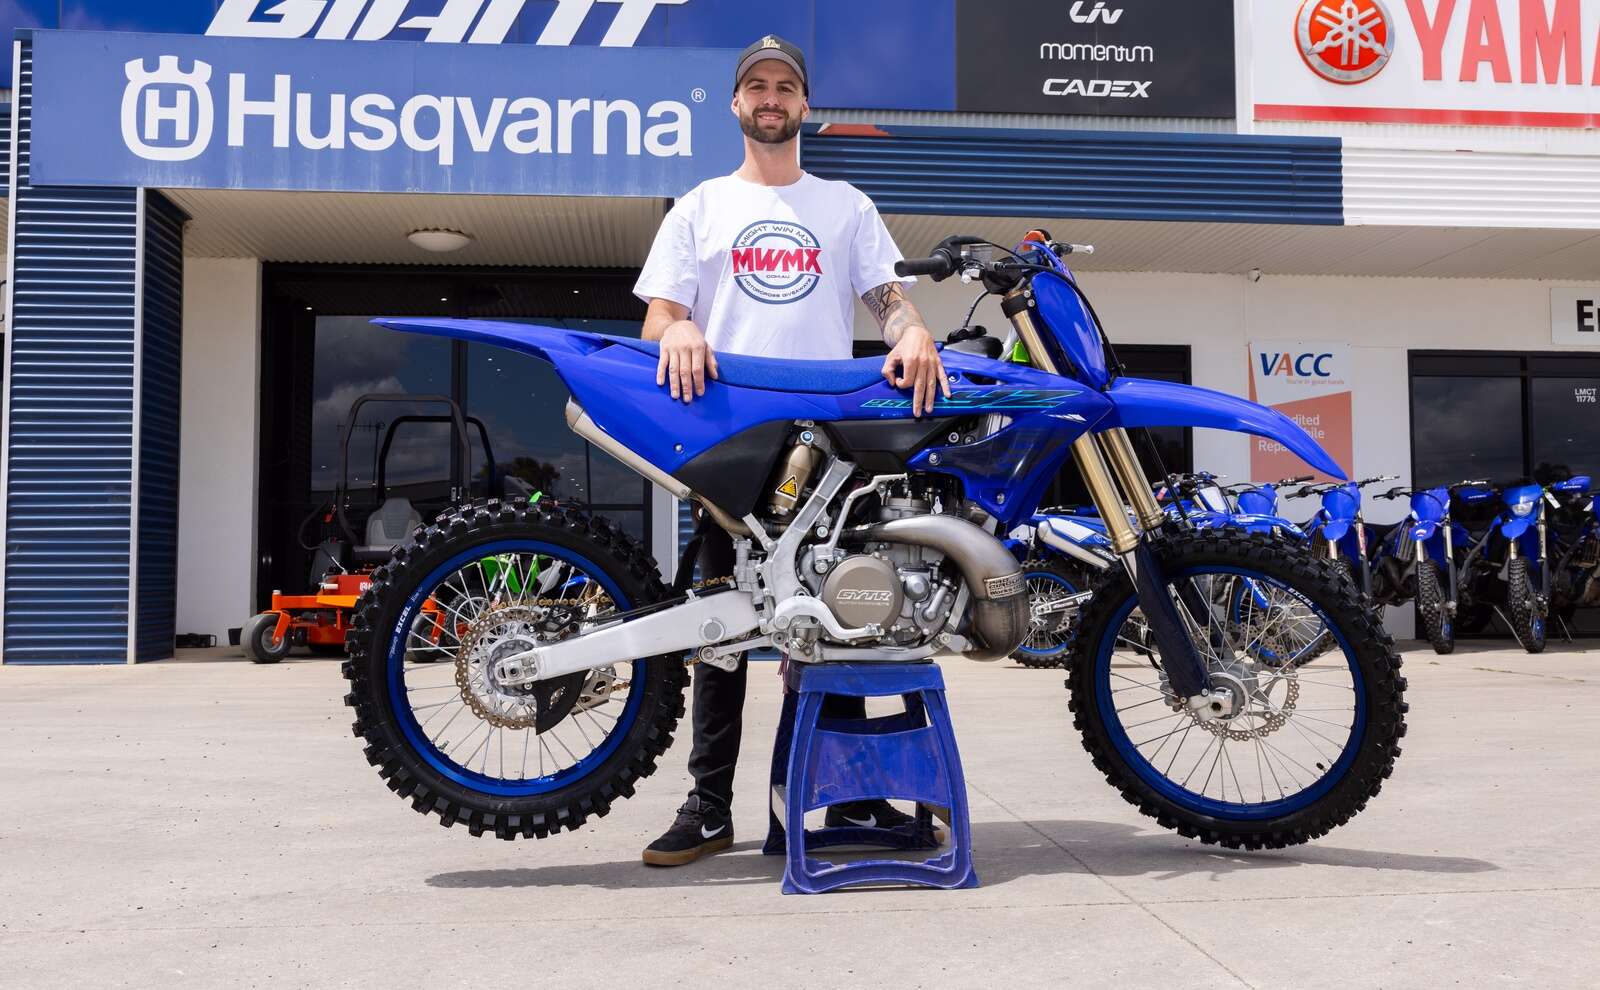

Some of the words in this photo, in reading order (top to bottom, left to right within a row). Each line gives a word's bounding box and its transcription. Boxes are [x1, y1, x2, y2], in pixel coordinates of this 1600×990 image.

[1069, 1, 1124, 24] Liv
[1040, 43, 1153, 62] momentum
[1404, 0, 1600, 86] YAMA
[1042, 78, 1153, 98] CADEX
[741, 225, 767, 246] MIGHT
[772, 225, 794, 234] WIN
[796, 231, 812, 245] MX
[731, 247, 823, 275] MWMX
[1260, 352, 1333, 377] VACC
[1574, 388, 1597, 396] LMCT
[1575, 395, 1597, 403] 11776
[395, 606, 412, 634] EXCEL
